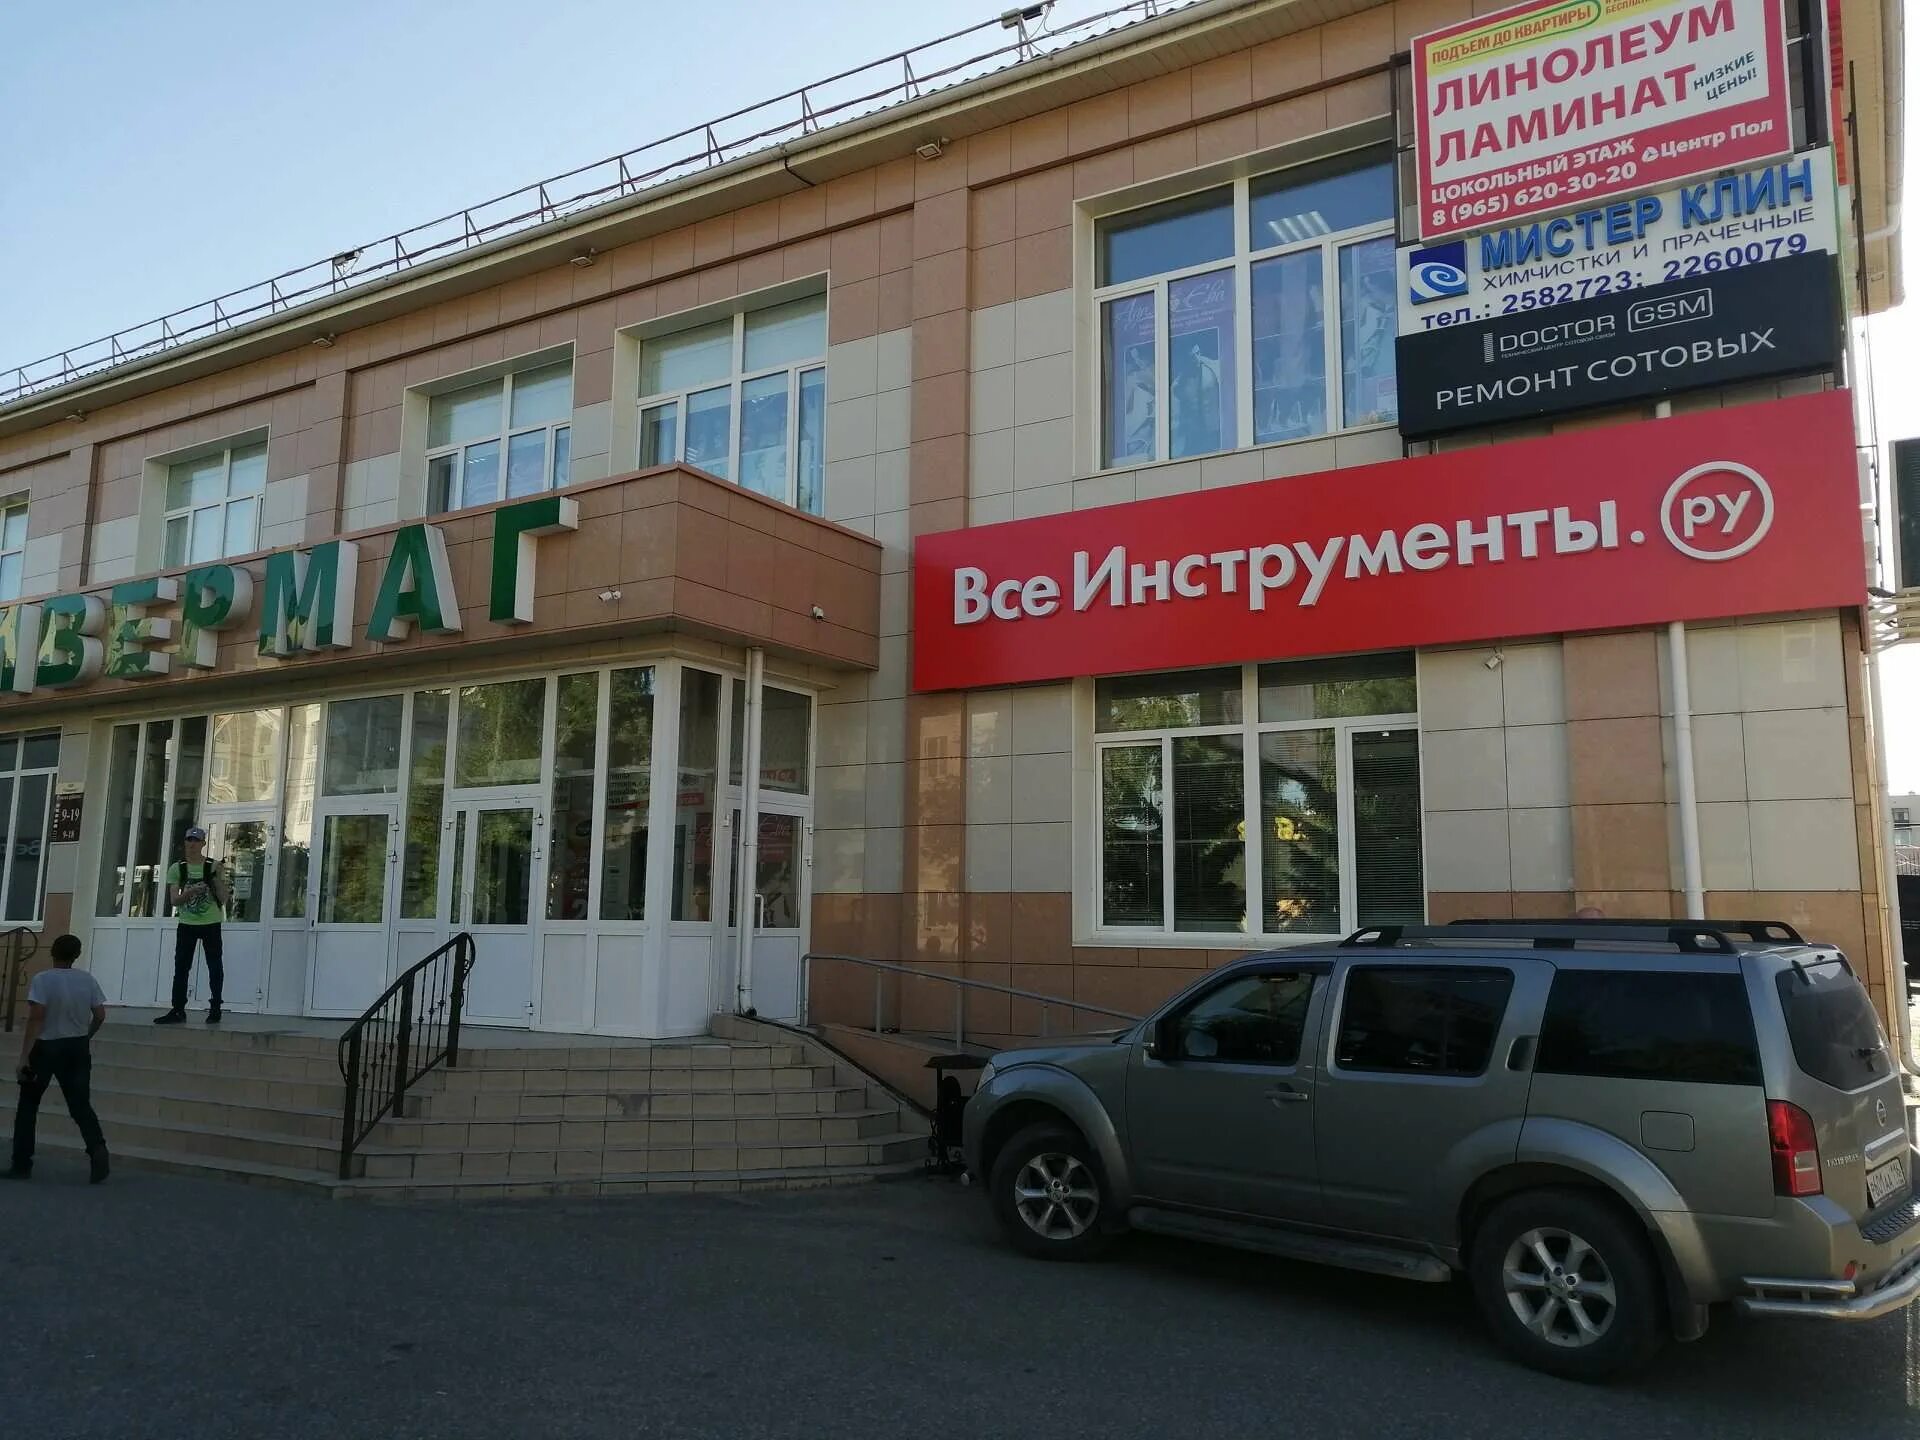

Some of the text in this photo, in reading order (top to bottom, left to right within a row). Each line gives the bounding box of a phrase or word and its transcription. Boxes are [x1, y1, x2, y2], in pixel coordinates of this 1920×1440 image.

[1432, 5, 1592, 65] ПОДЪЕМ ДО КВАРТИРЫ
[1433, 0, 1735, 117] ЛИНОЛЕУМ
[1694, 50, 1755, 91] НИЗКИЕ
[1706, 67, 1757, 101] ЦЕНЫ!
[1435, 63, 1697, 168] ЛАМИНАТ
[1660, 119, 1773, 158] Центр Пол
[1432, 137, 1635, 204] ЦОКОЛЬНЫЙ ЭТАЖ
[1432, 161, 1637, 226] 8 (965) 620-30-20
[1480, 158, 1813, 272] МИСТЕР КЛИН
[1482, 206, 1815, 292] ХИМЧИСТКИ И ПРАЧЕЧНЫЕ
[1663, 232, 1808, 283] 2260079
[1500, 294, 1706, 352] DOCTOR GSM
[1437, 327, 1777, 411] РЕМОНТ СОТОВЫХ
[954, 566, 1060, 625] Все
[1682, 489, 1752, 539] ру
[61, 808, 80, 822] 9-19
